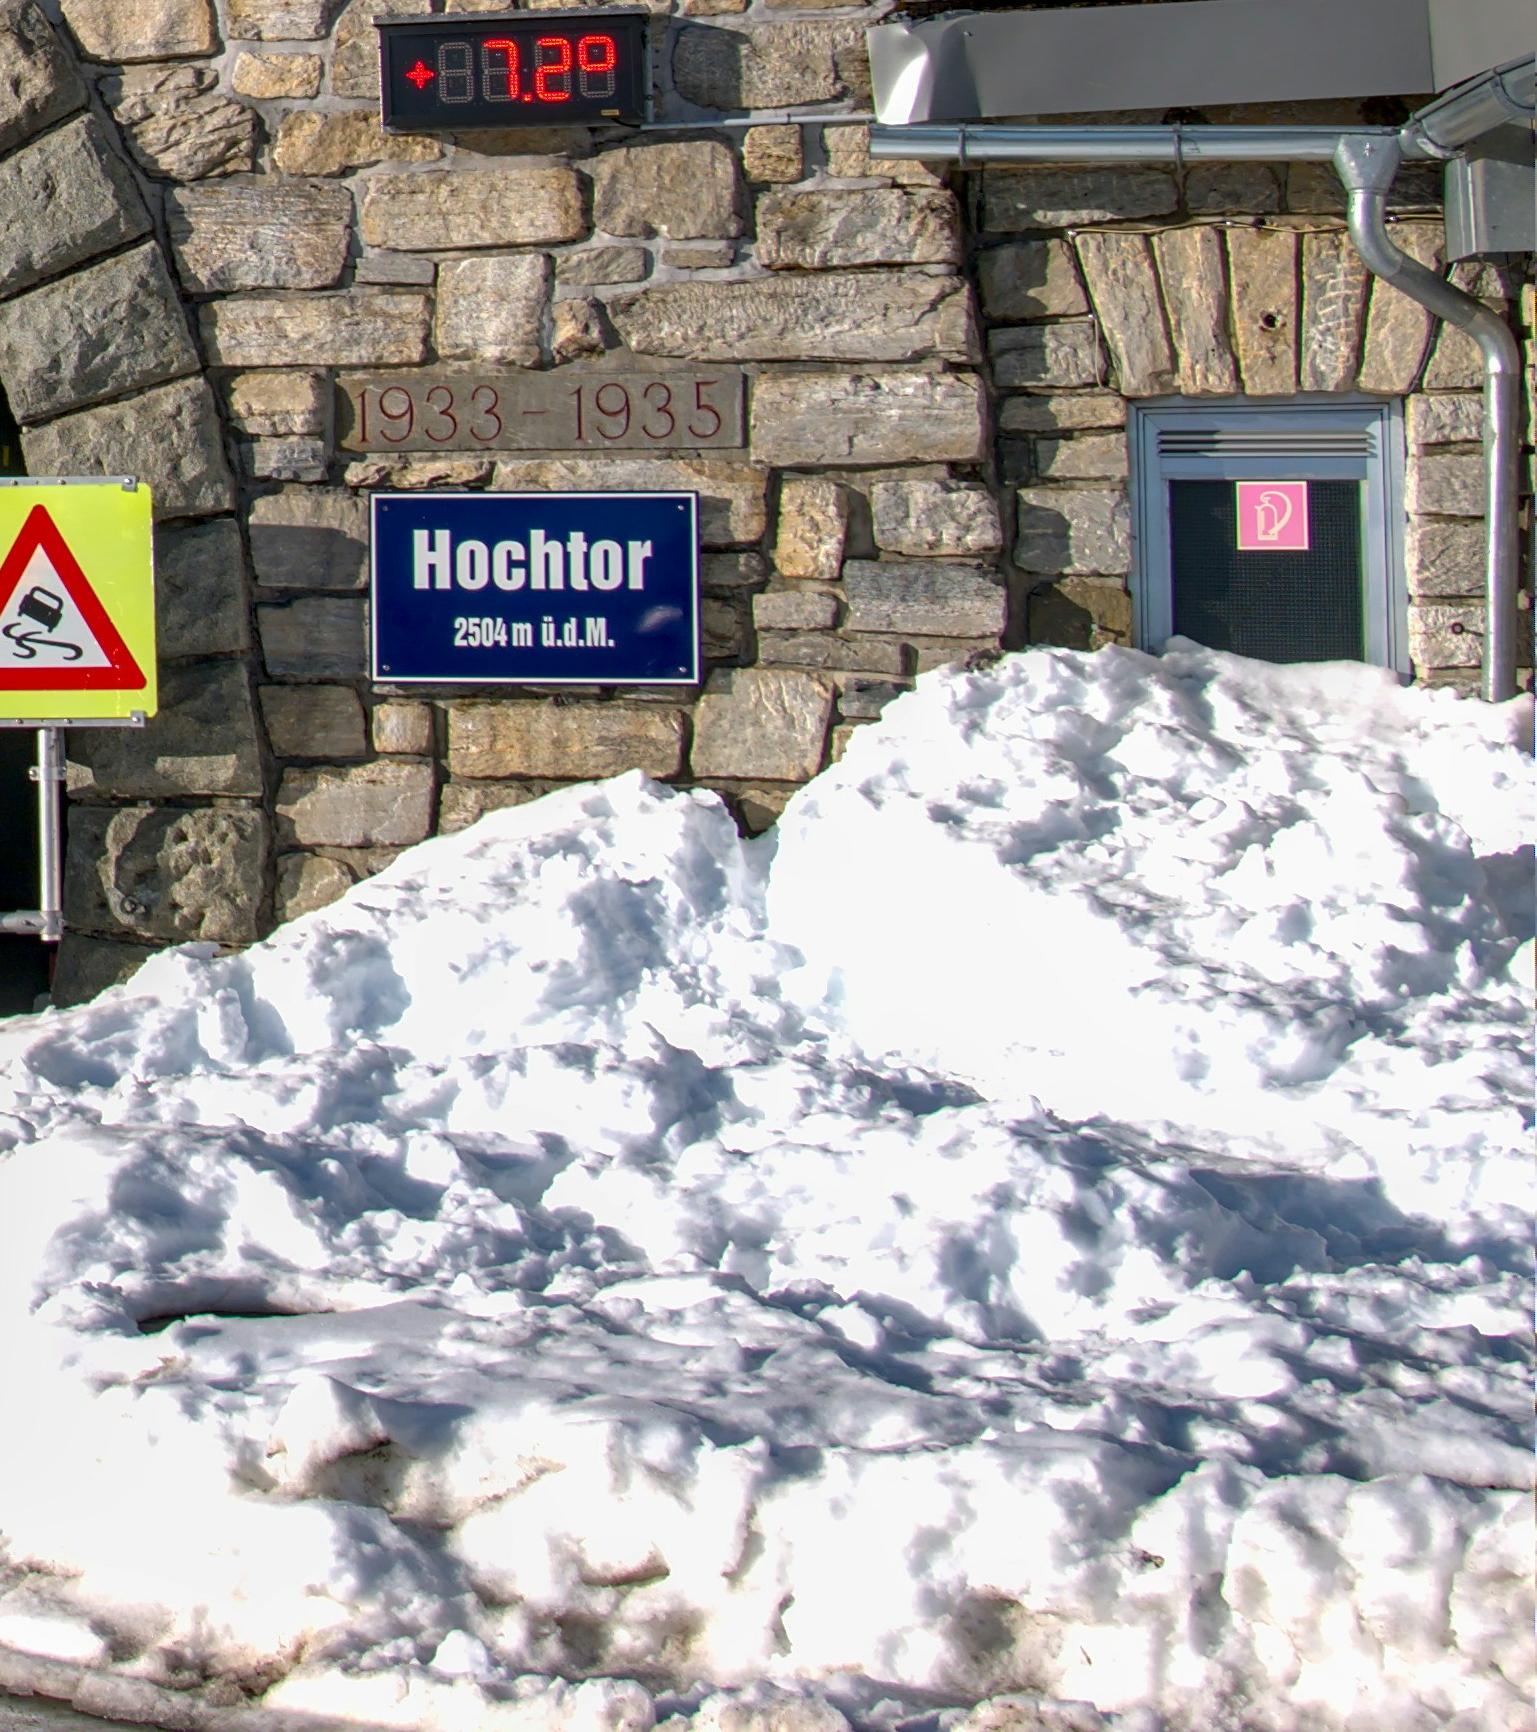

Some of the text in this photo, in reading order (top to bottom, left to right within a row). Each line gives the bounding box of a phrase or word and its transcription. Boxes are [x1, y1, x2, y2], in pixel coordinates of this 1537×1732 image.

[354, 385, 503, 444] 1933
[568, 379, 722, 441] 1935
[412, 528, 654, 591] Hochtor
[453, 615, 616, 648] 2504 m ü.d.M.
